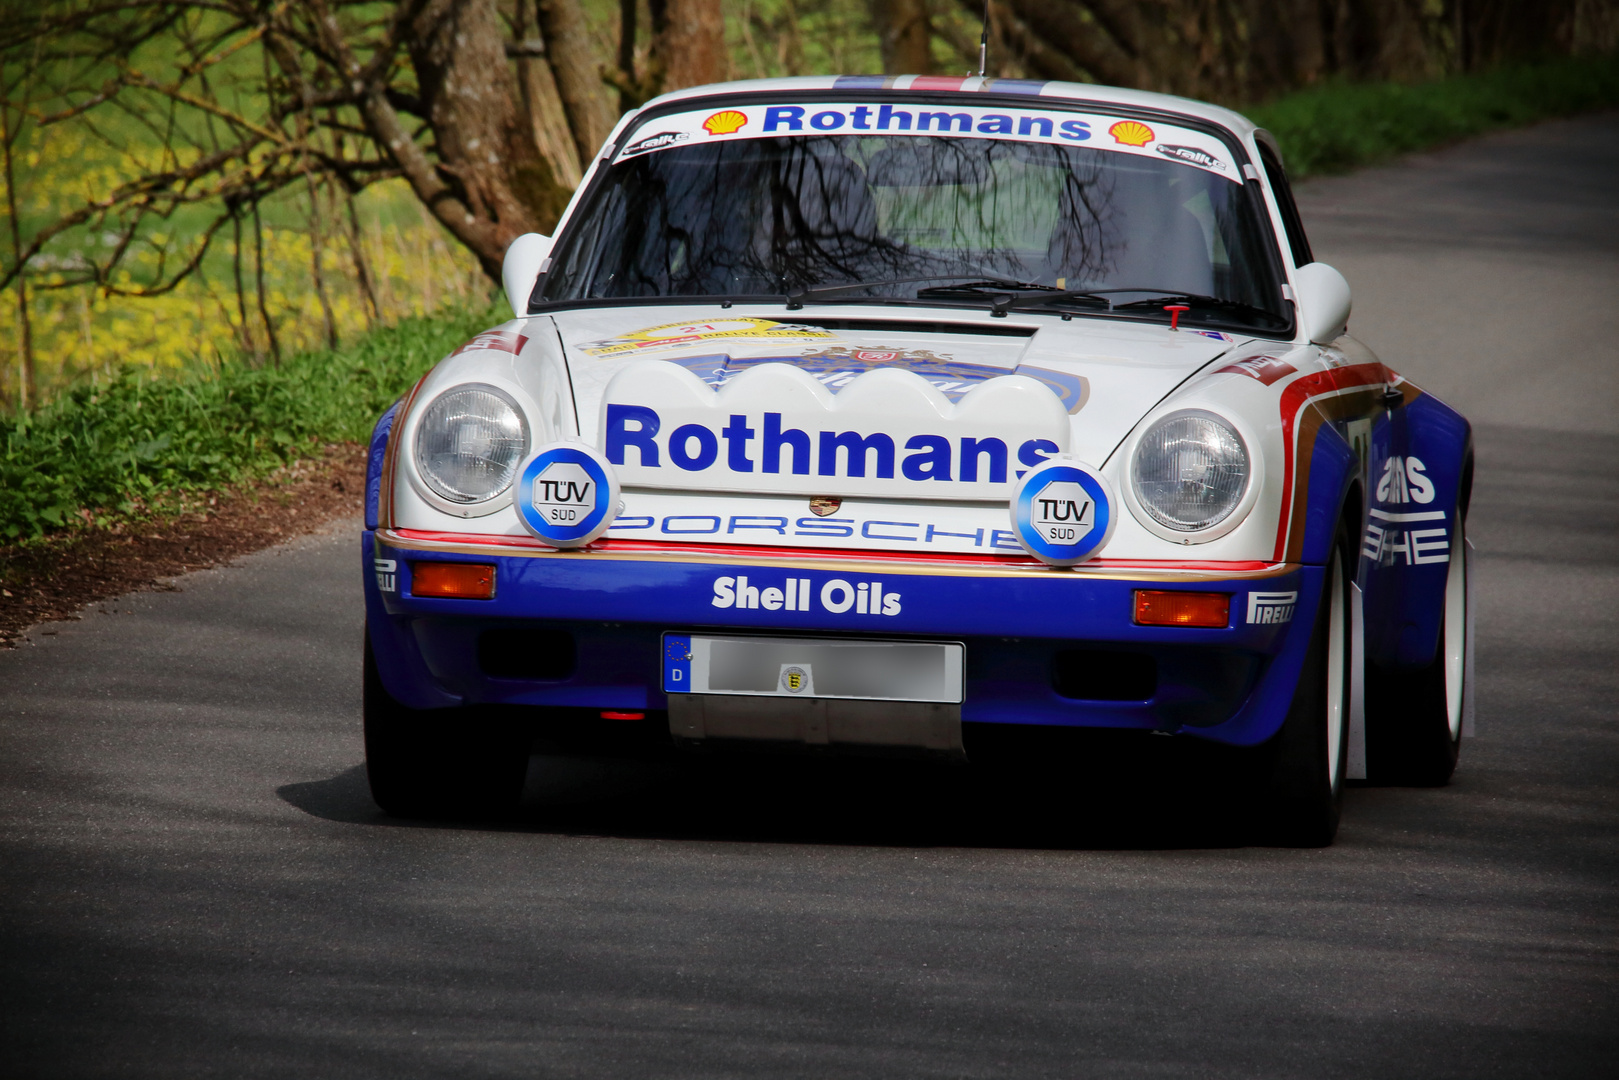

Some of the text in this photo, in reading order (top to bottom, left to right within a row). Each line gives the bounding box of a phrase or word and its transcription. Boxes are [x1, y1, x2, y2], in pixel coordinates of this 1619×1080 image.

[762, 104, 1092, 142] Rothmans
[679, 324, 716, 334] 21
[606, 403, 1061, 486] Rothmans
[540, 480, 590, 502] TÜV
[551, 508, 577, 521] SÜD
[1038, 498, 1090, 521] TÜV
[607, 515, 1035, 551] PORSCHE
[1050, 528, 1075, 540] SÜD
[711, 575, 902, 617] Shell Oils
[1246, 591, 1298, 624] PIRELLI
[672, 669, 683, 681] D
